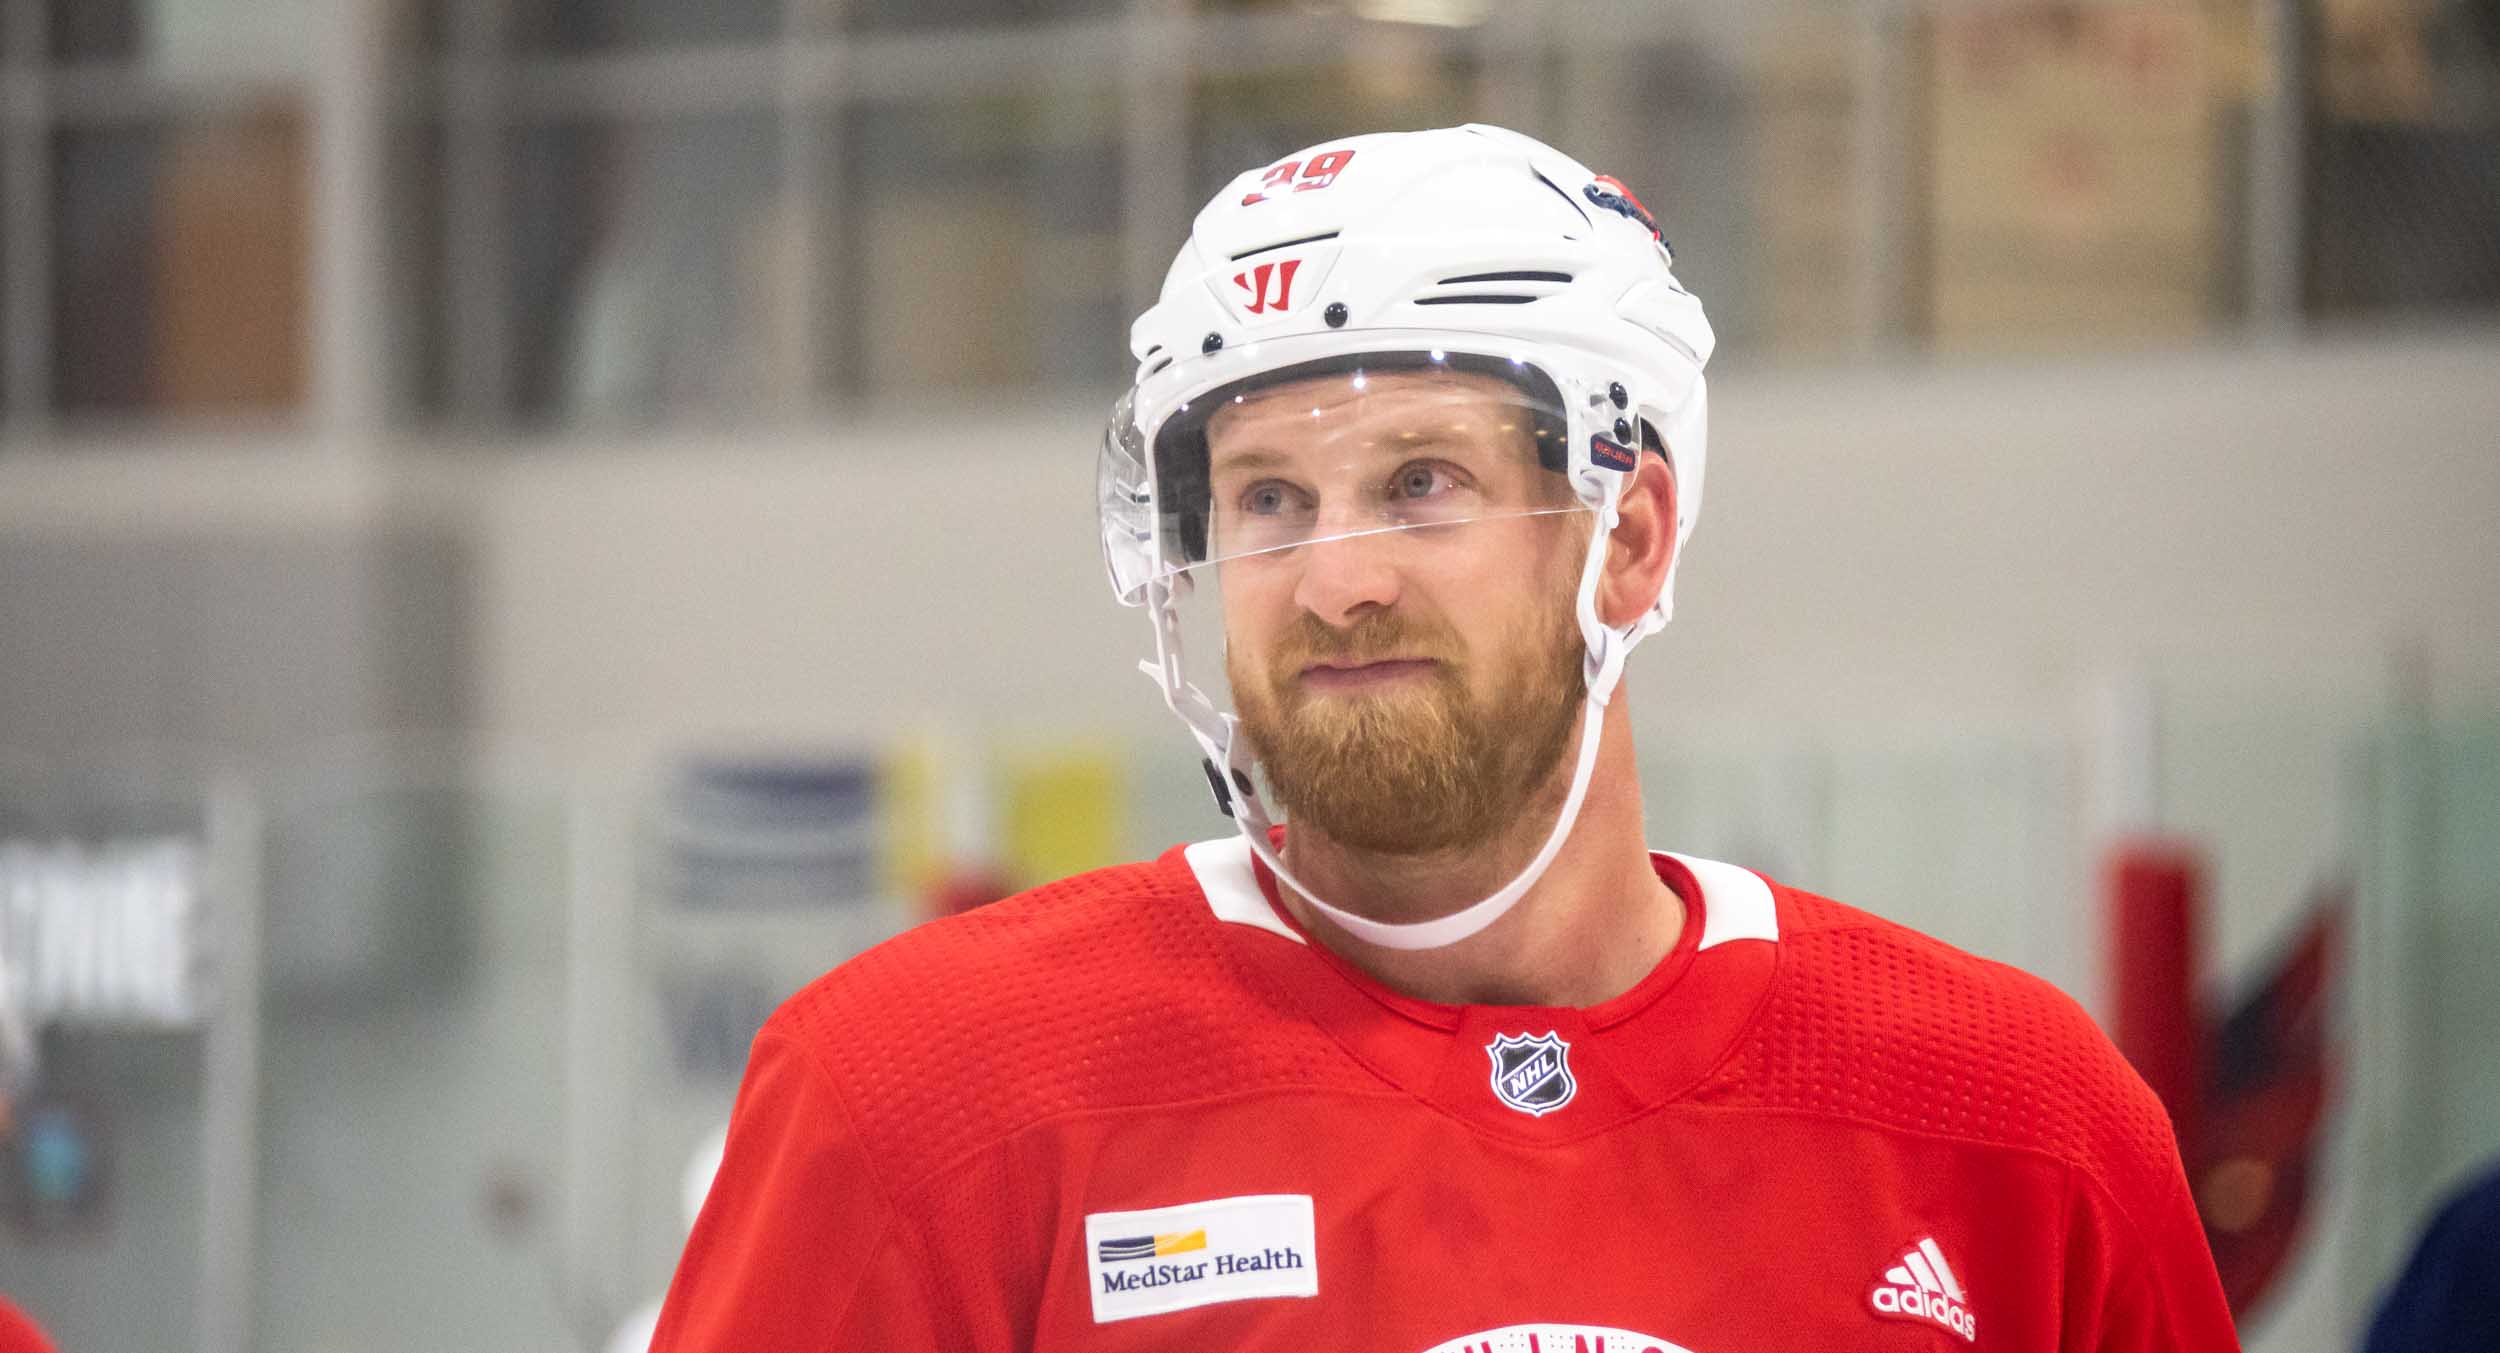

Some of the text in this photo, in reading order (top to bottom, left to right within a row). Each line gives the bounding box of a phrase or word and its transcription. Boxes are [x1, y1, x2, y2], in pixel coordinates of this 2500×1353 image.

[1509, 1053, 1555, 1097] NHL
[1102, 1248, 1303, 1293] MedStar Health
[1872, 1284, 1976, 1342] adidas
